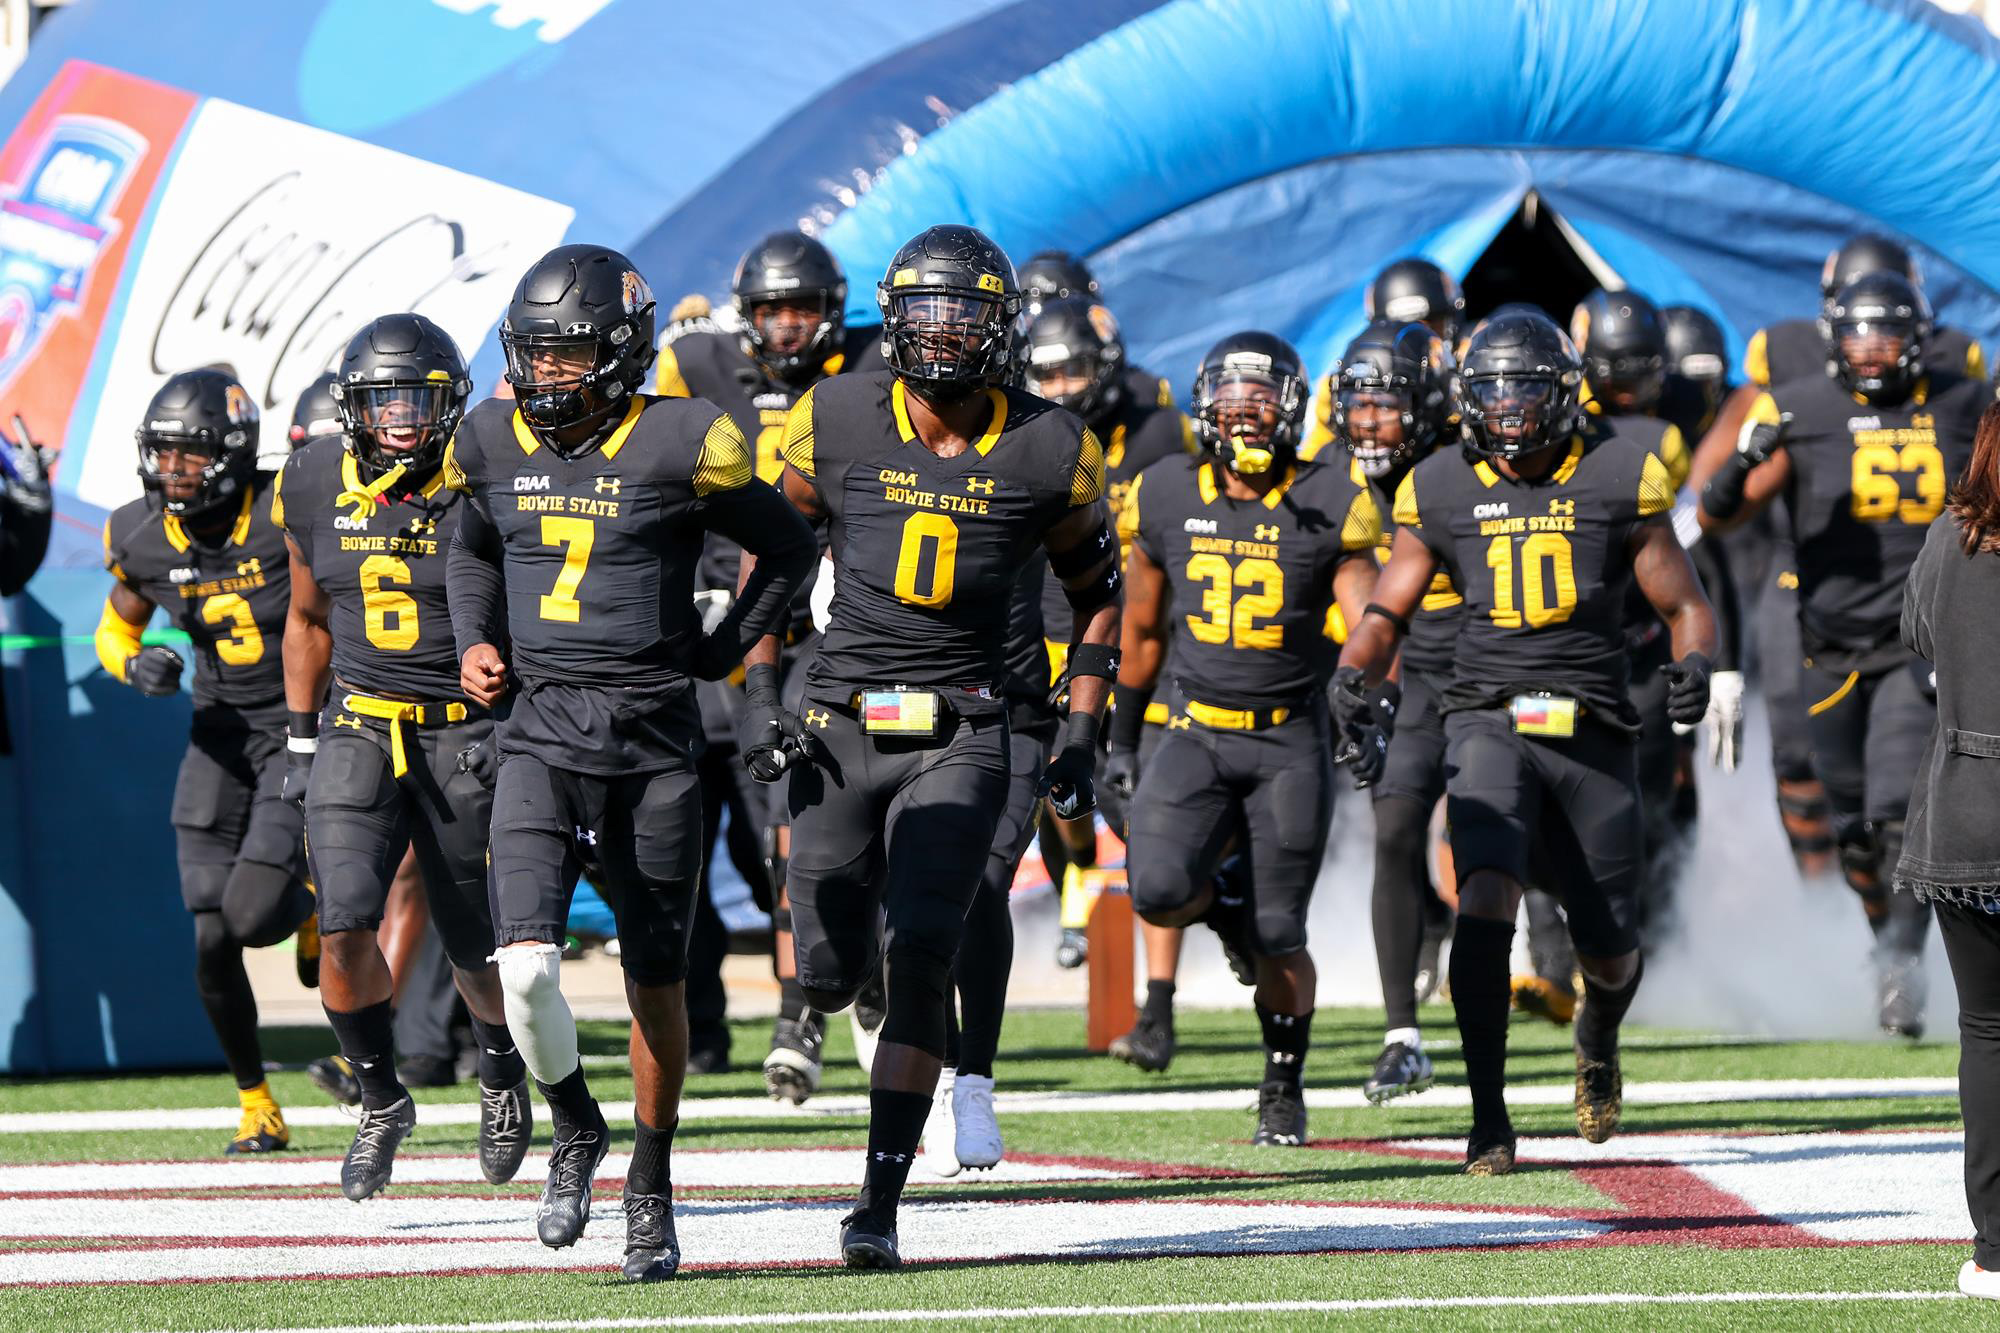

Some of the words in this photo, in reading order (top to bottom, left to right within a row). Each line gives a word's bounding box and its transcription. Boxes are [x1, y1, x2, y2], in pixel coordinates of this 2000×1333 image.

[514, 475, 551, 491] CIAA
[517, 495, 566, 511] BOWIE
[569, 497, 620, 518] STATE
[880, 469, 919, 486] CIAA
[885, 486, 935, 508] BOWIE
[939, 494, 989, 515] STATE
[1851, 445, 1946, 525] 63
[340, 536, 386, 551] BOWIE
[389, 537, 438, 555] STATE
[894, 511, 958, 610] 0
[1480, 517, 1526, 536] BOWIE
[1528, 516, 1576, 531] STATE
[359, 554, 420, 650] 6
[540, 515, 595, 623] 7
[1186, 553, 1284, 650] 32
[1487, 532, 1577, 629] 10
[202, 592, 265, 666] 3
